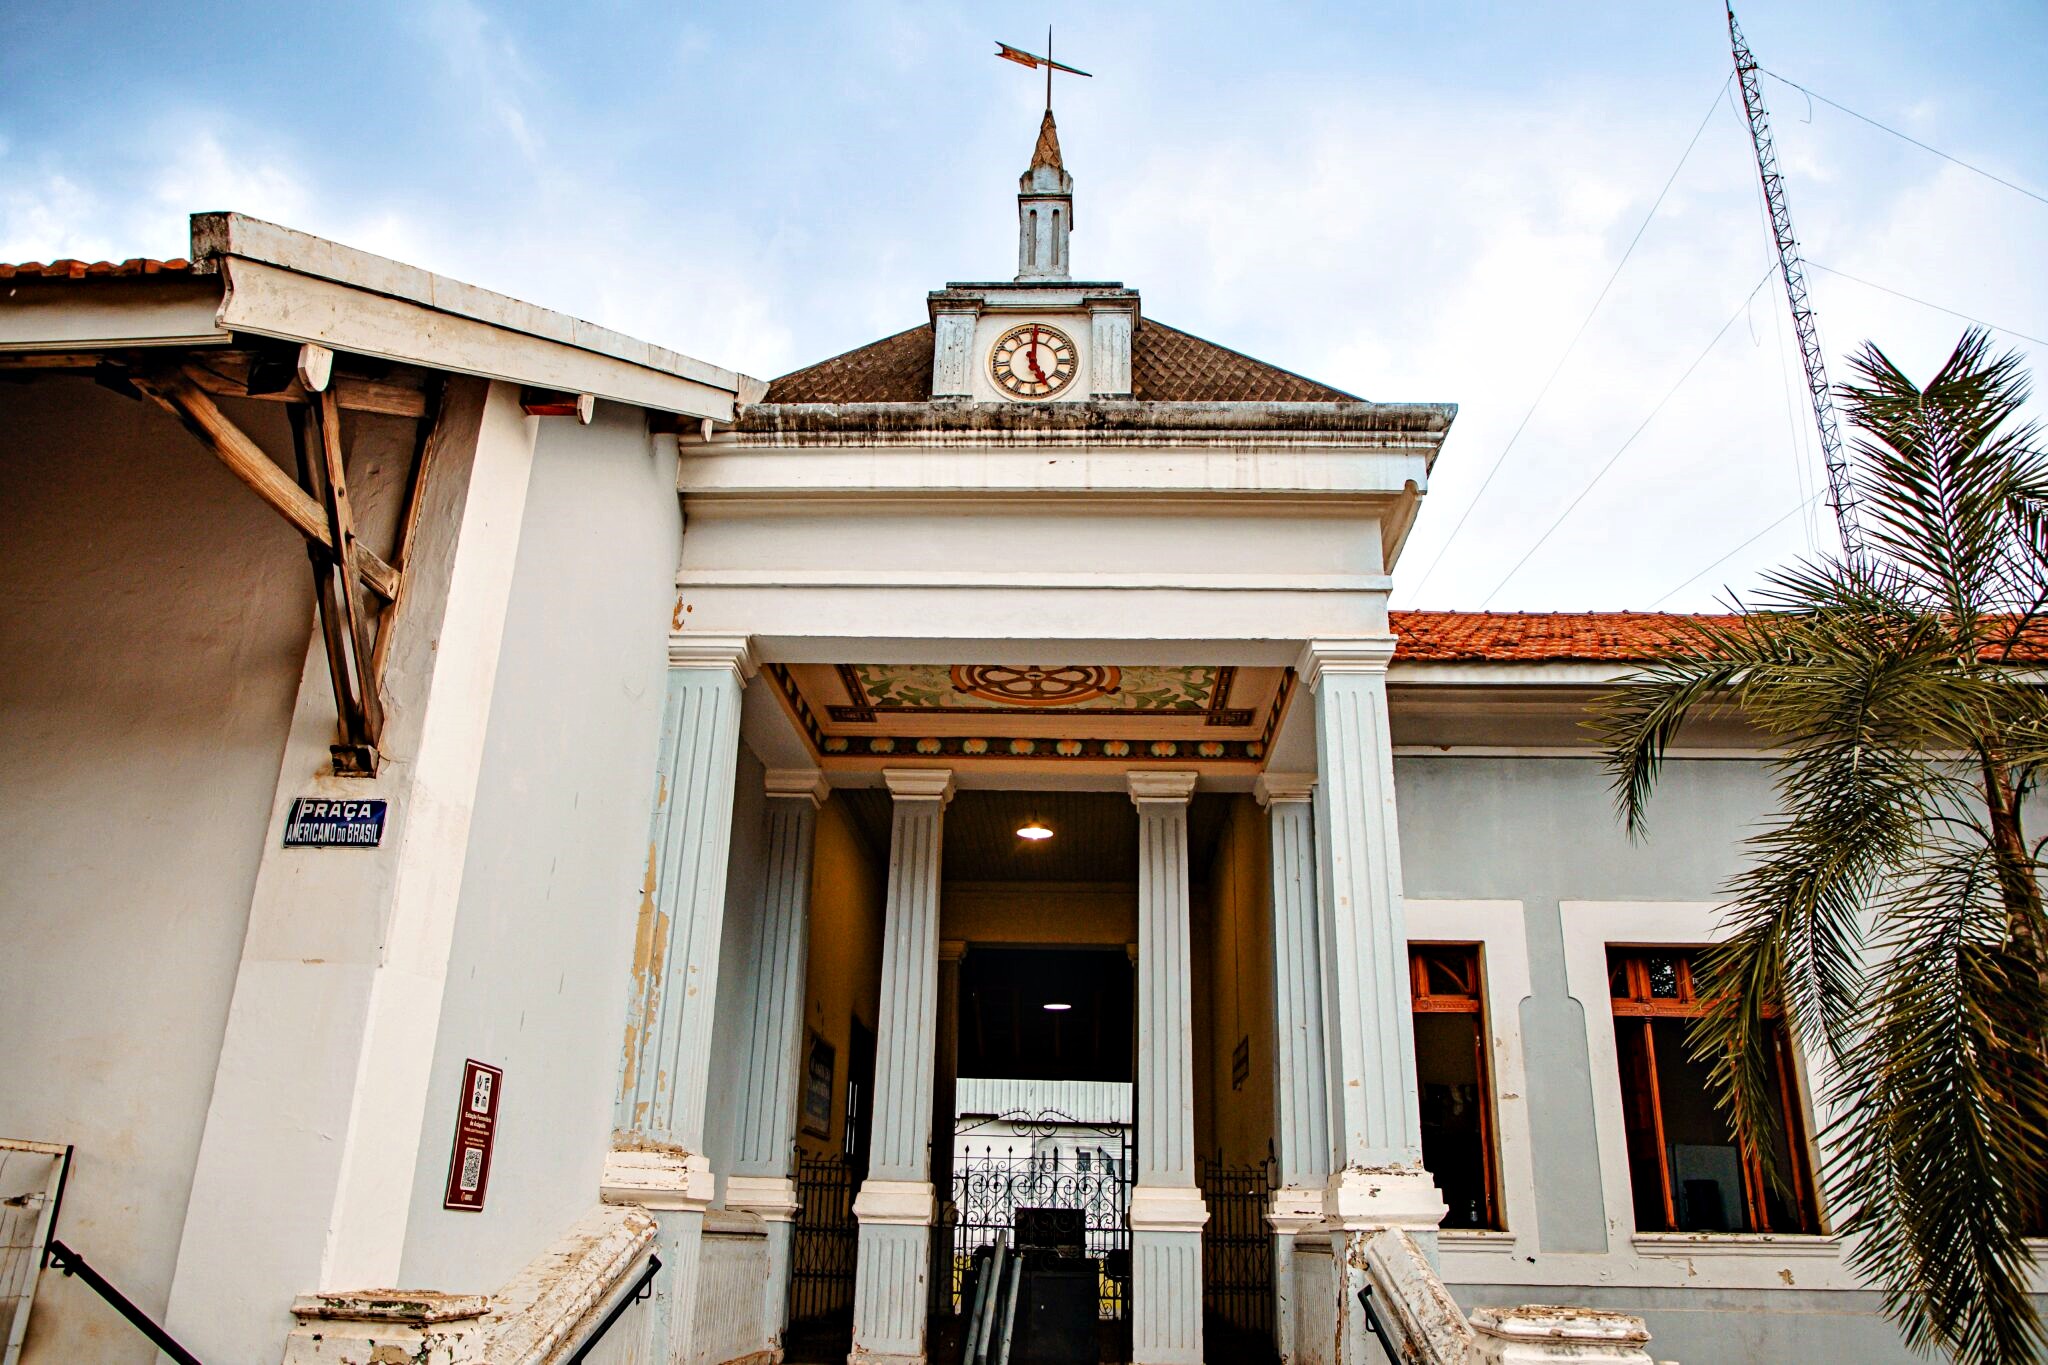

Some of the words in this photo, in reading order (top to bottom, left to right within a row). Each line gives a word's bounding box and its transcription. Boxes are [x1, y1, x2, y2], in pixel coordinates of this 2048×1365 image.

[301, 802, 371, 821] PRAÇA
[286, 823, 337, 842] AMERICANO
[347, 823, 378, 843] BRASIL
